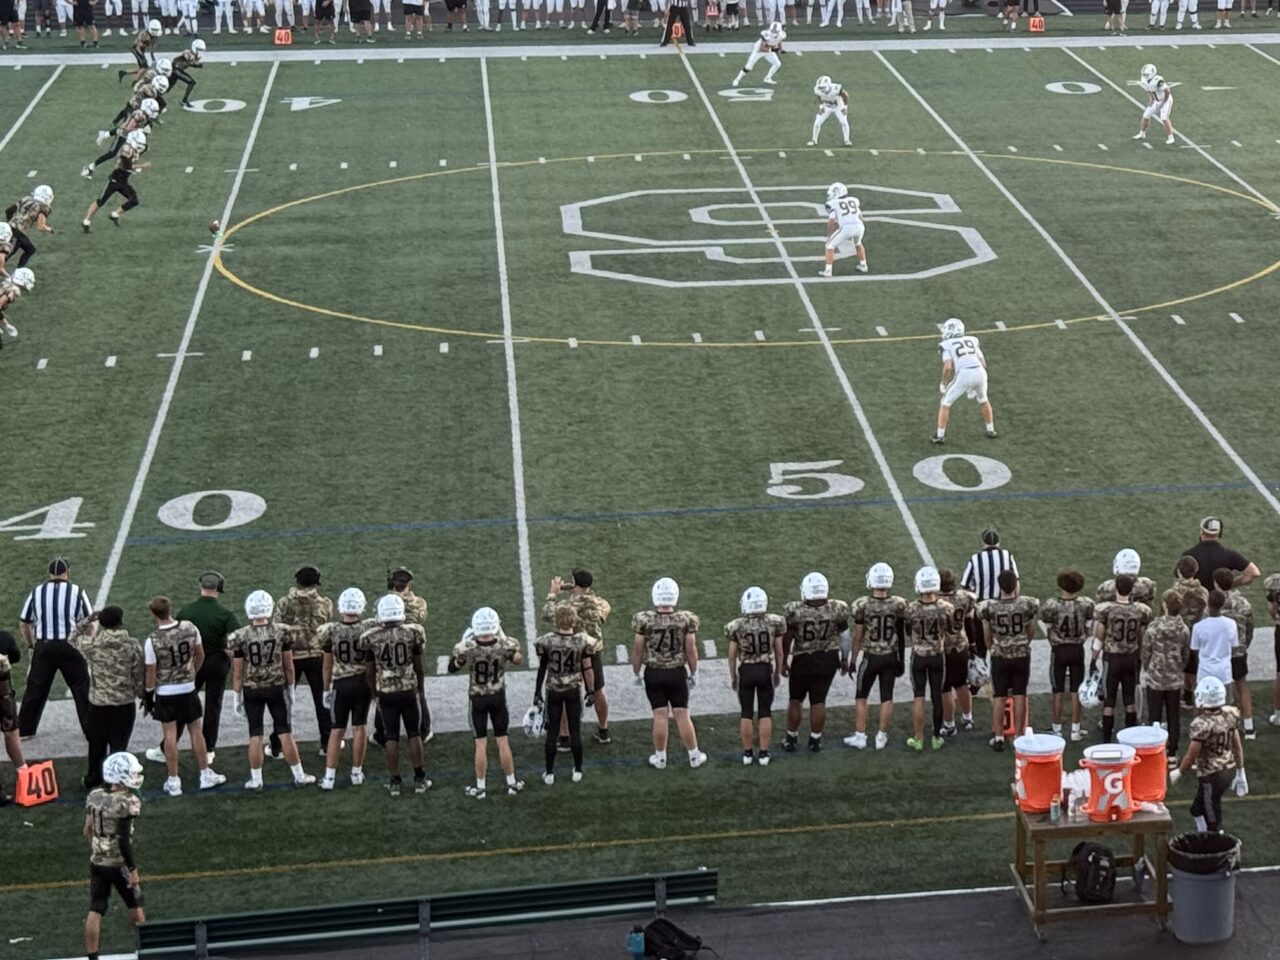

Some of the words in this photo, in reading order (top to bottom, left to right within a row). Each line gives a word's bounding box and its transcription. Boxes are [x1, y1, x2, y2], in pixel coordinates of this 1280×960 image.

[839, 201, 859, 216] 99
[952, 339, 976, 357] 29
[803, 619, 831, 642] 67
[869, 614, 895, 642] 36
[919, 619, 939, 641] 14
[998, 612, 1024, 636] 58
[1059, 614, 1080, 638] 41
[1112, 618, 1138, 643] 32
[247, 638, 277, 667] 87
[653, 628, 676, 653] 71
[744, 631, 770, 655] 38
[169, 640, 191, 668] 18
[381, 642, 407, 667] 40
[474, 658, 500, 685] 81
[27, 767, 56, 800] 40
[1103, 771, 1124, 795] G
